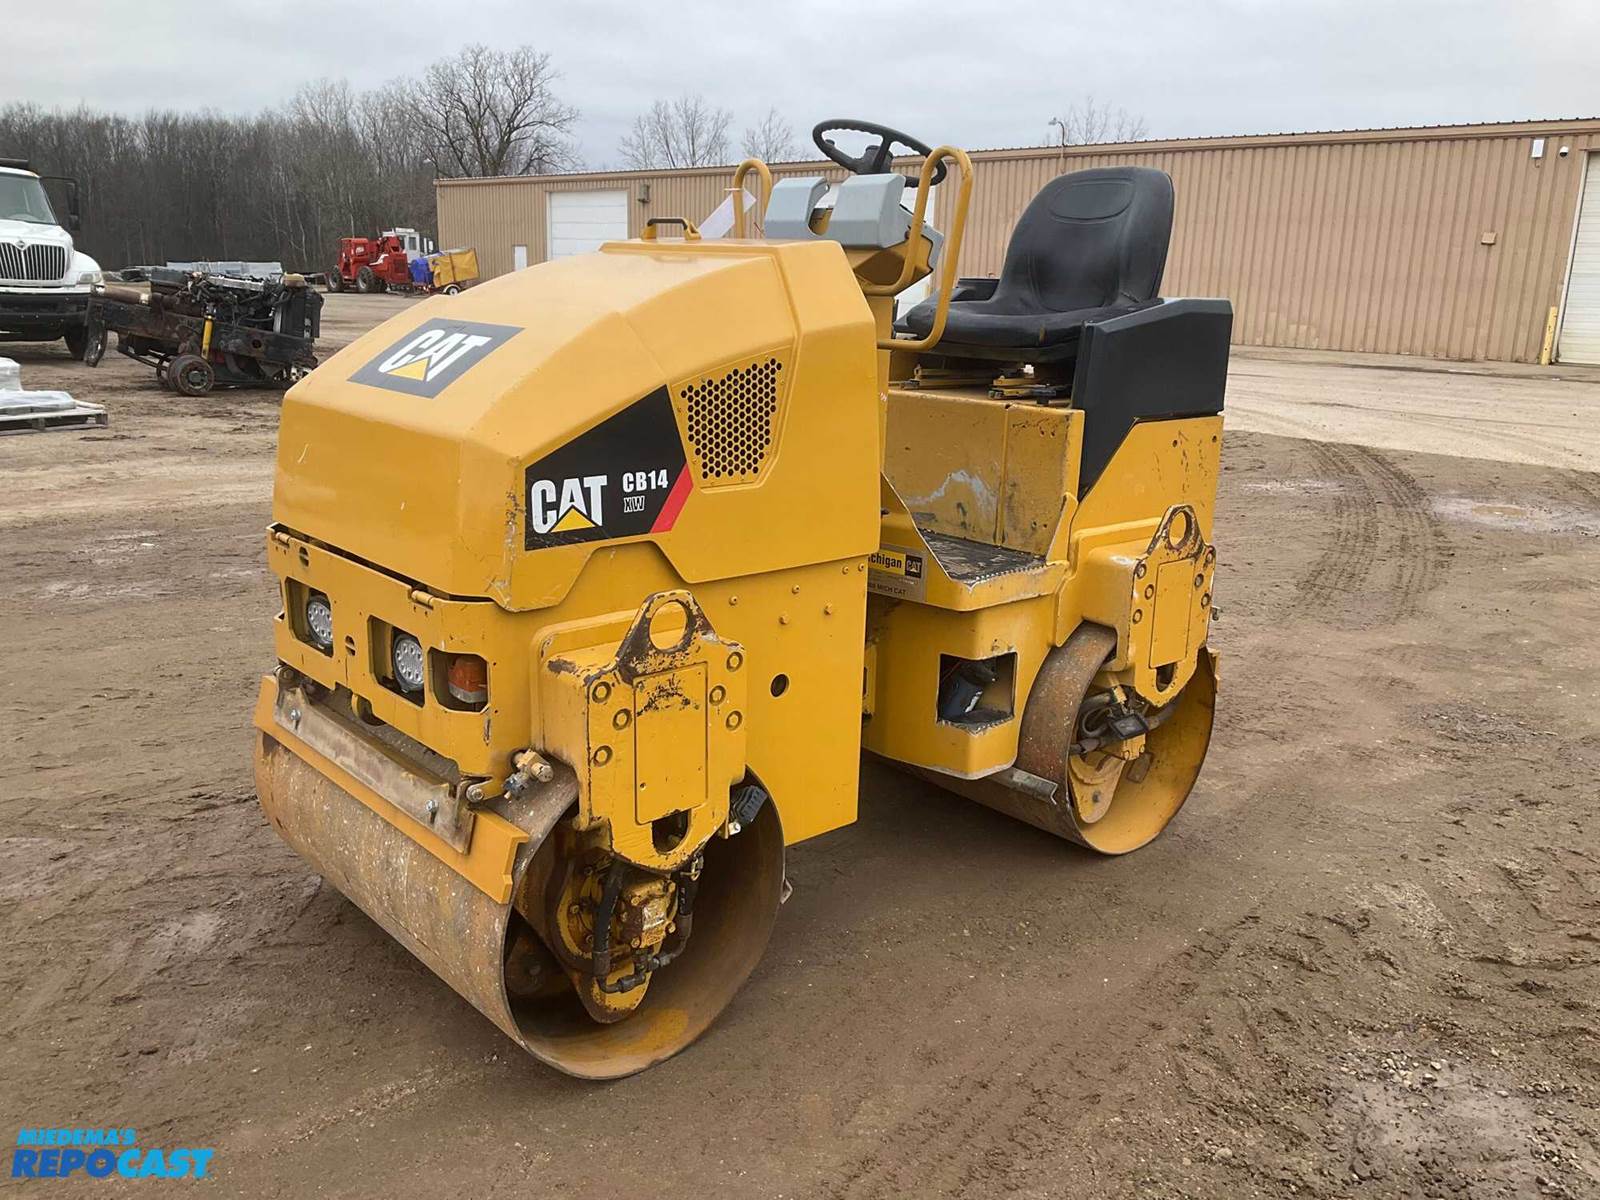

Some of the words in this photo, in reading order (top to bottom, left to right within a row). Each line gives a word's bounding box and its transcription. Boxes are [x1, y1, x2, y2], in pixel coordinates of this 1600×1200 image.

[378, 329, 492, 382] CAT
[531, 475, 608, 534] CAT
[622, 469, 669, 493] CB14
[623, 496, 645, 513] XW
[868, 553, 902, 568] chigan
[906, 560, 921, 573] CAT
[894, 587, 906, 596] CAT
